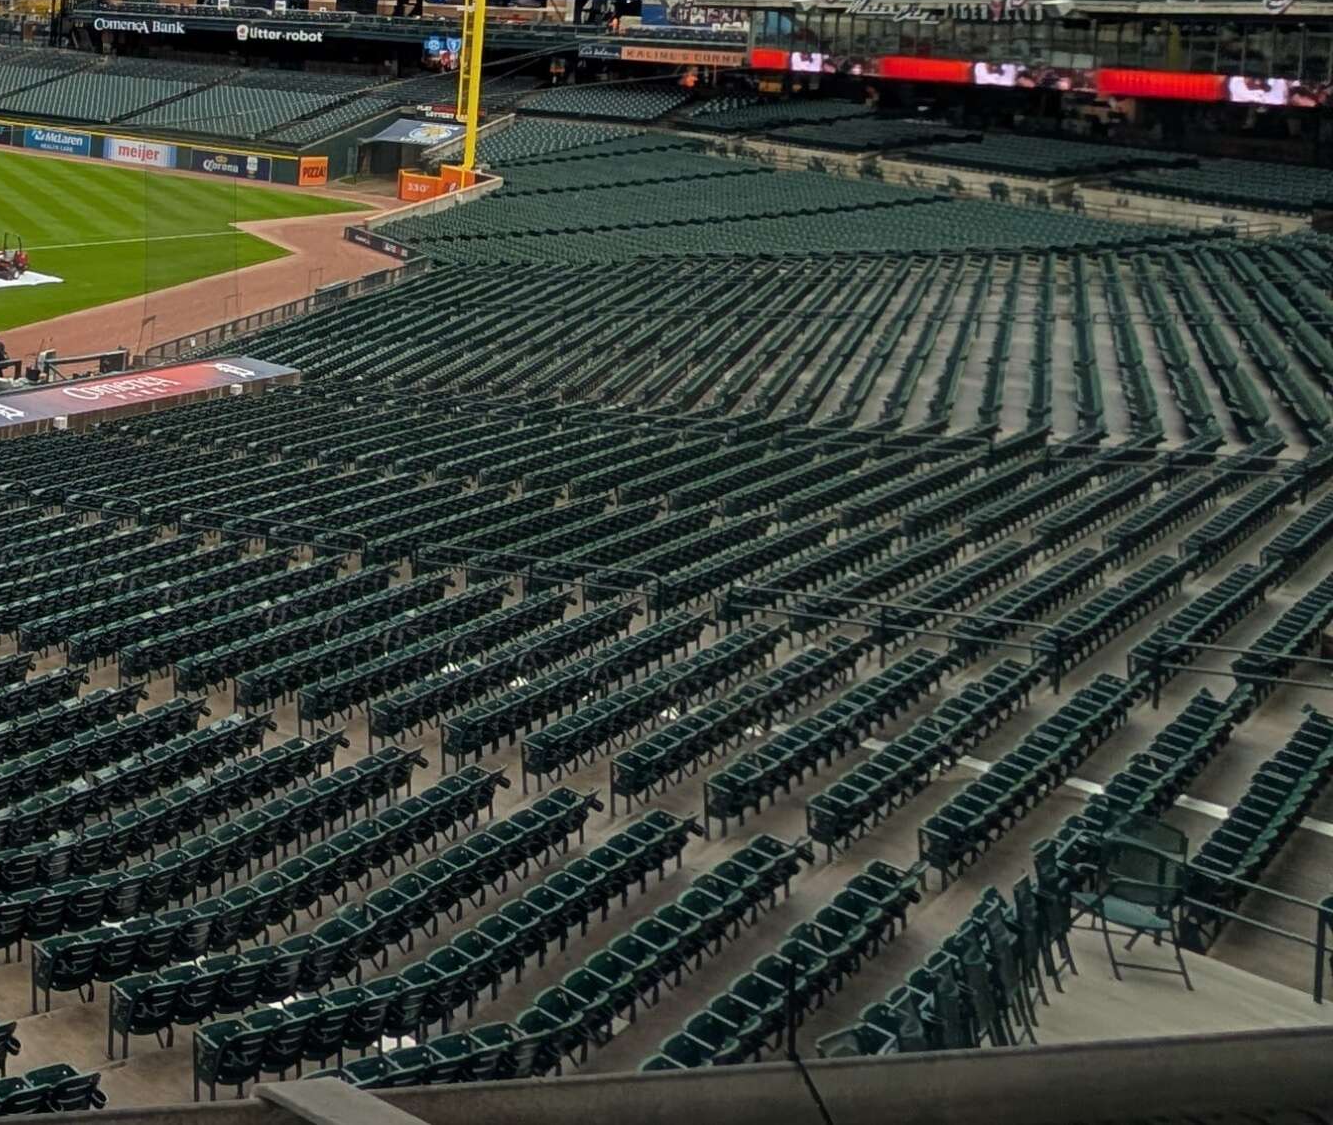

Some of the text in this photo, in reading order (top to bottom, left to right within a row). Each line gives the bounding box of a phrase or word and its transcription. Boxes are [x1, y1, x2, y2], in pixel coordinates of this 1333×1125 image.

[152, 20, 185, 34] Bank
[45, 130, 83, 146] McLaren
[118, 143, 160, 161] meijer
[202, 159, 239, 174] Corona
[302, 165, 327, 179] PIZZA!
[115, 388, 168, 400] PARK
